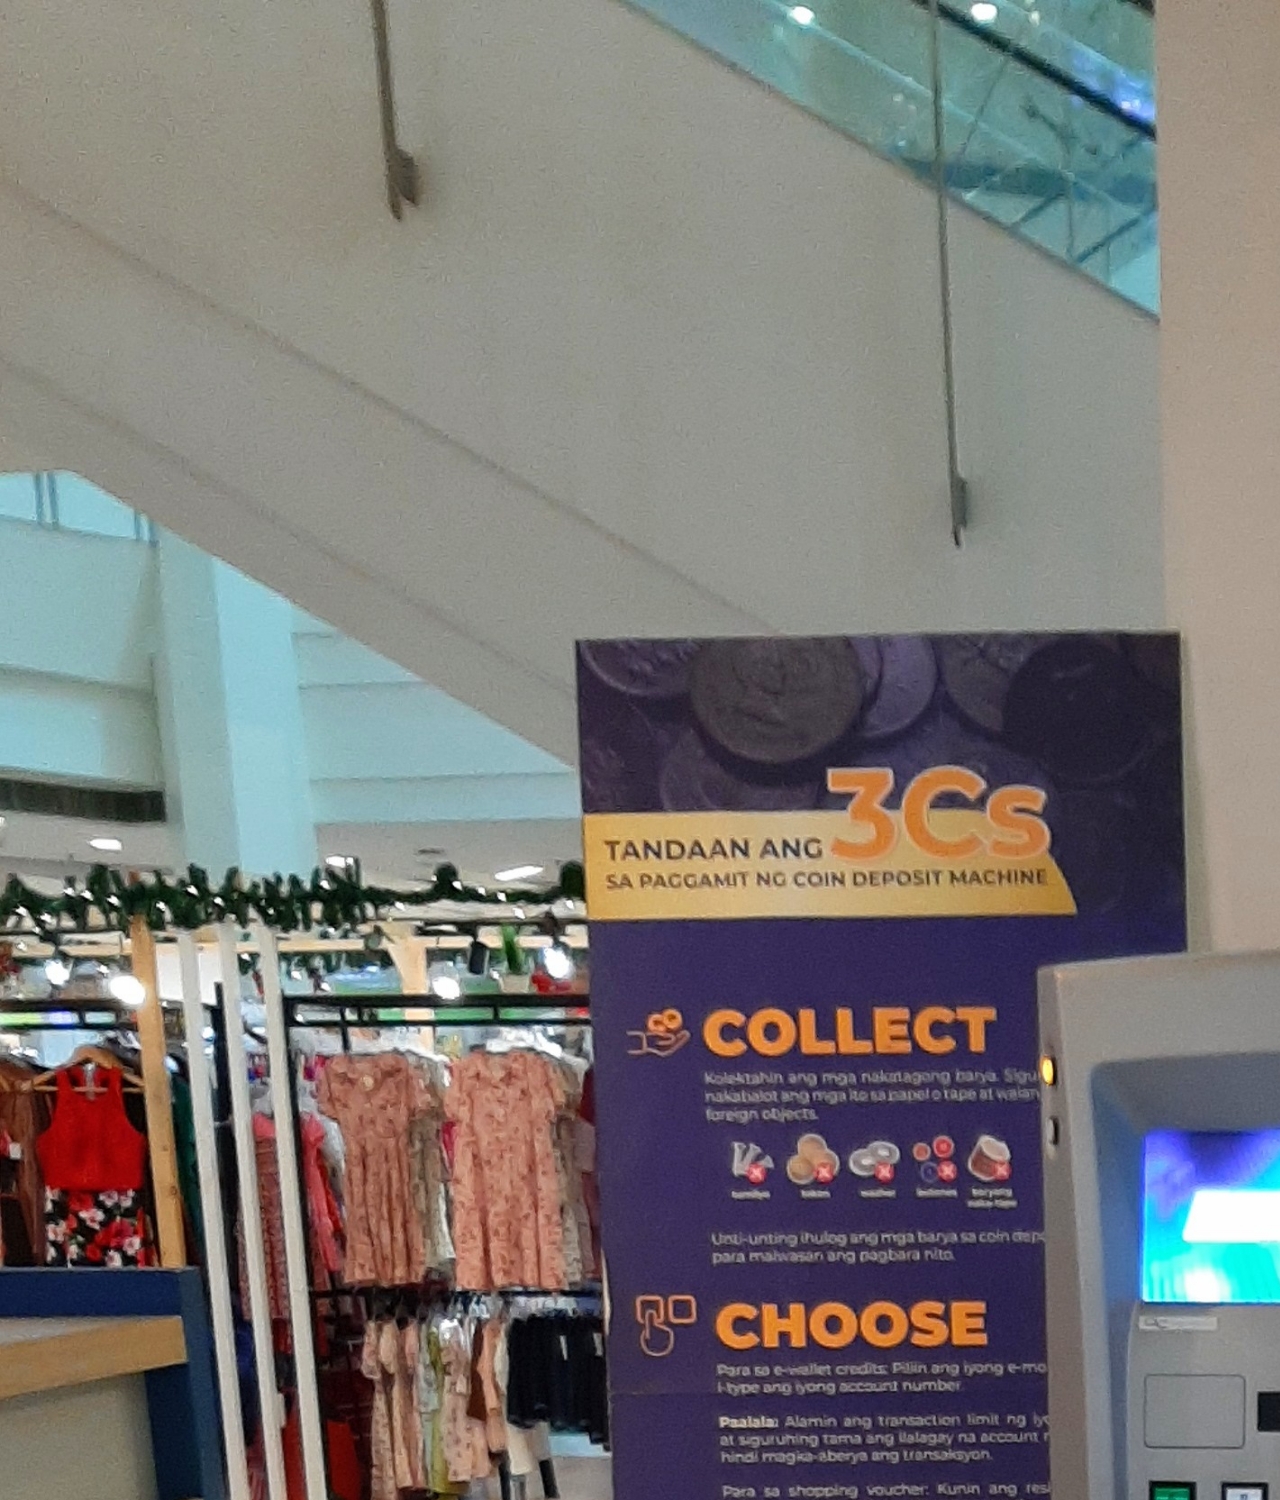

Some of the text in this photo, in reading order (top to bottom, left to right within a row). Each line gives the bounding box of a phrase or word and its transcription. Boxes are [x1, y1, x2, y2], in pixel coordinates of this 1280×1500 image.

[605, 764, 1052, 863] TANDAAN ANG 3Cs
[606, 866, 1048, 889] SA PAGGAMIT NG COIN DEPOSIT MACHINE
[703, 1006, 998, 1057] COLLECT
[788, 1071, 818, 1088] ang
[822, 1071, 857, 1088] mga
[781, 1089, 810, 1105] ang
[813, 1089, 847, 1105] mga
[706, 1107, 760, 1125] foreign
[849, 1232, 879, 1247] ang
[881, 1231, 915, 1246] mga
[960, 1231, 977, 1245] sa
[827, 1250, 856, 1265] ang
[715, 1300, 989, 1350] CHOOSE
[716, 1363, 750, 1378] Para
[754, 1364, 771, 1377] sa
[931, 1362, 960, 1378] ang
[763, 1381, 792, 1397] ang
[838, 1380, 898, 1394] account
[784, 1413, 838, 1429] Alamin
[843, 1415, 873, 1431] ang
[878, 1412, 962, 1429] transaction
[967, 1412, 1001, 1427] limit
[1006, 1413, 1027, 1429] ng
[719, 1433, 735, 1447] at
[822, 1432, 862, 1447] tama
[865, 1432, 895, 1448] ang
[957, 1431, 976, 1444] na
[980, 1429, 1039, 1444] account
[871, 1449, 900, 1465] ang
[722, 1484, 756, 1499] Para
[763, 1485, 781, 1498] sa
[788, 1483, 859, 1500] shopping
[936, 1482, 981, 1497] Kunin
[988, 1482, 1018, 1498] ang
